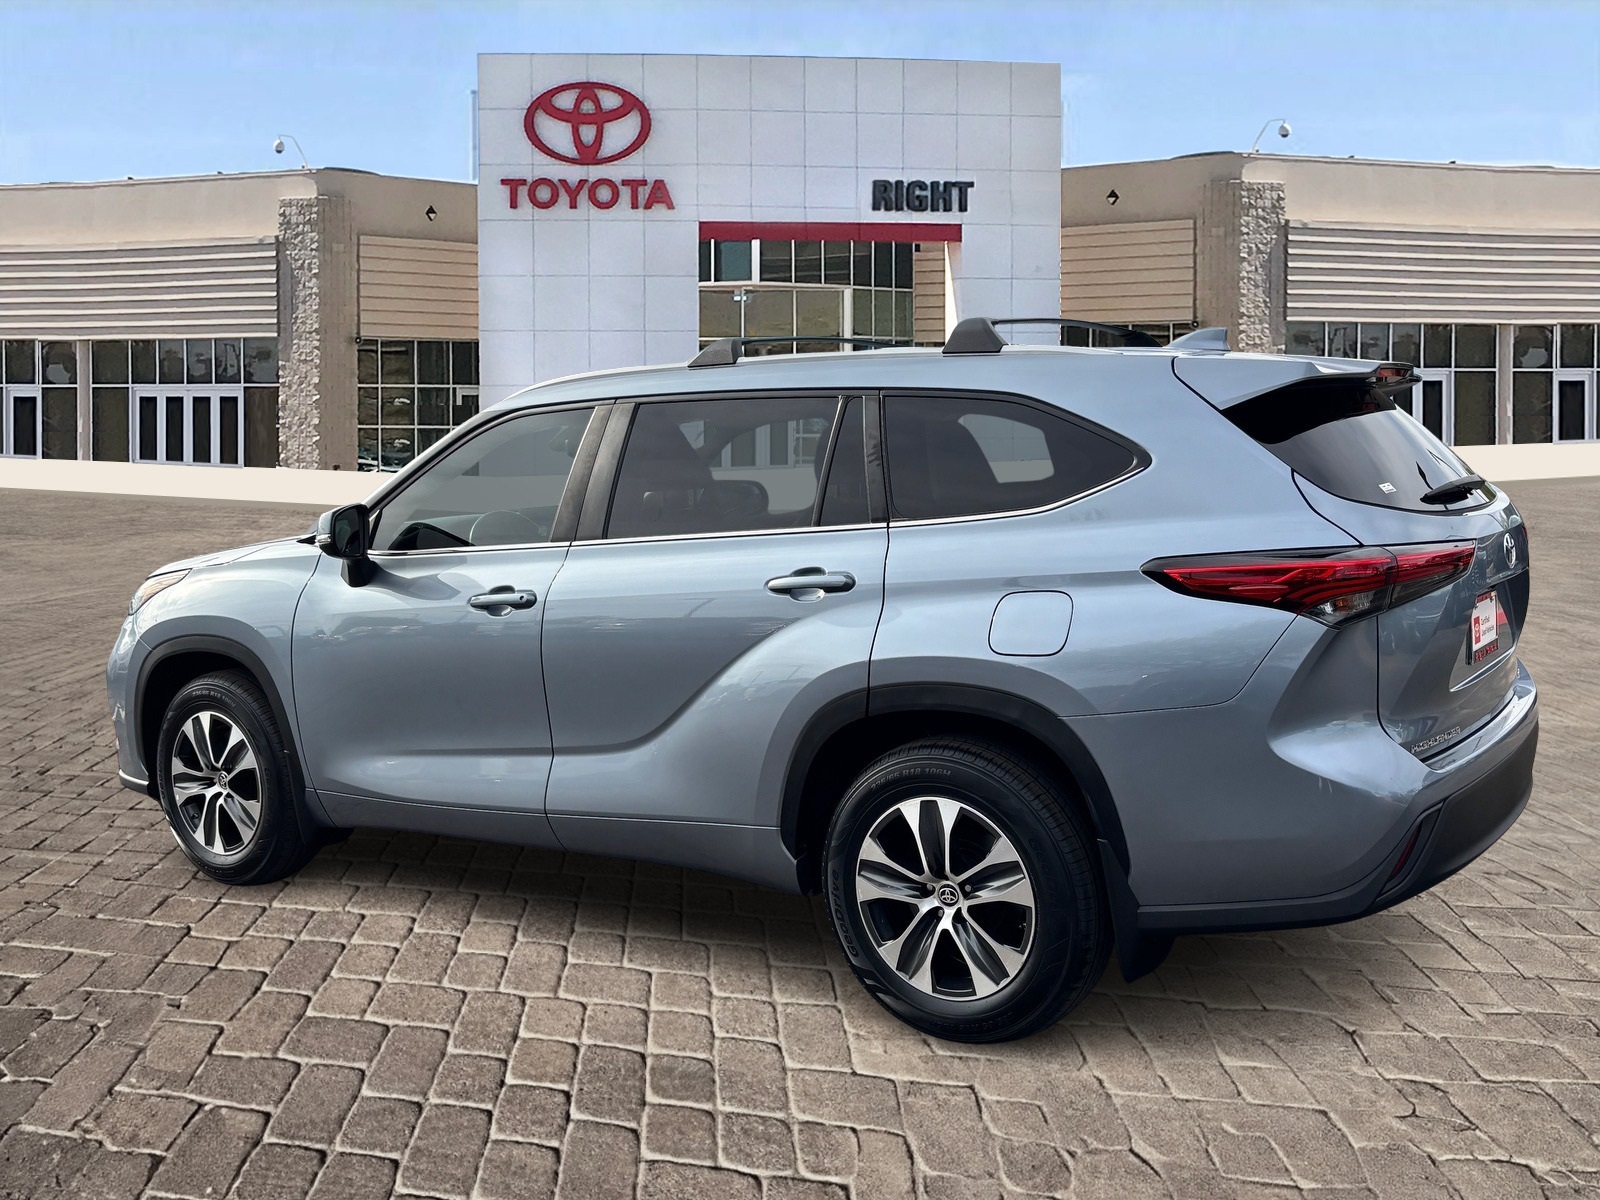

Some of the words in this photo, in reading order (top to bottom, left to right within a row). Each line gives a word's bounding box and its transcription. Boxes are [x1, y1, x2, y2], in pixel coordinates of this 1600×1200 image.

[500, 178, 676, 210] TOYOTA
[872, 179, 975, 213] RIGHT
[1410, 725, 1461, 754] HIGHLANDER
[902, 767, 921, 777] R18
[924, 767, 952, 776] 106H
